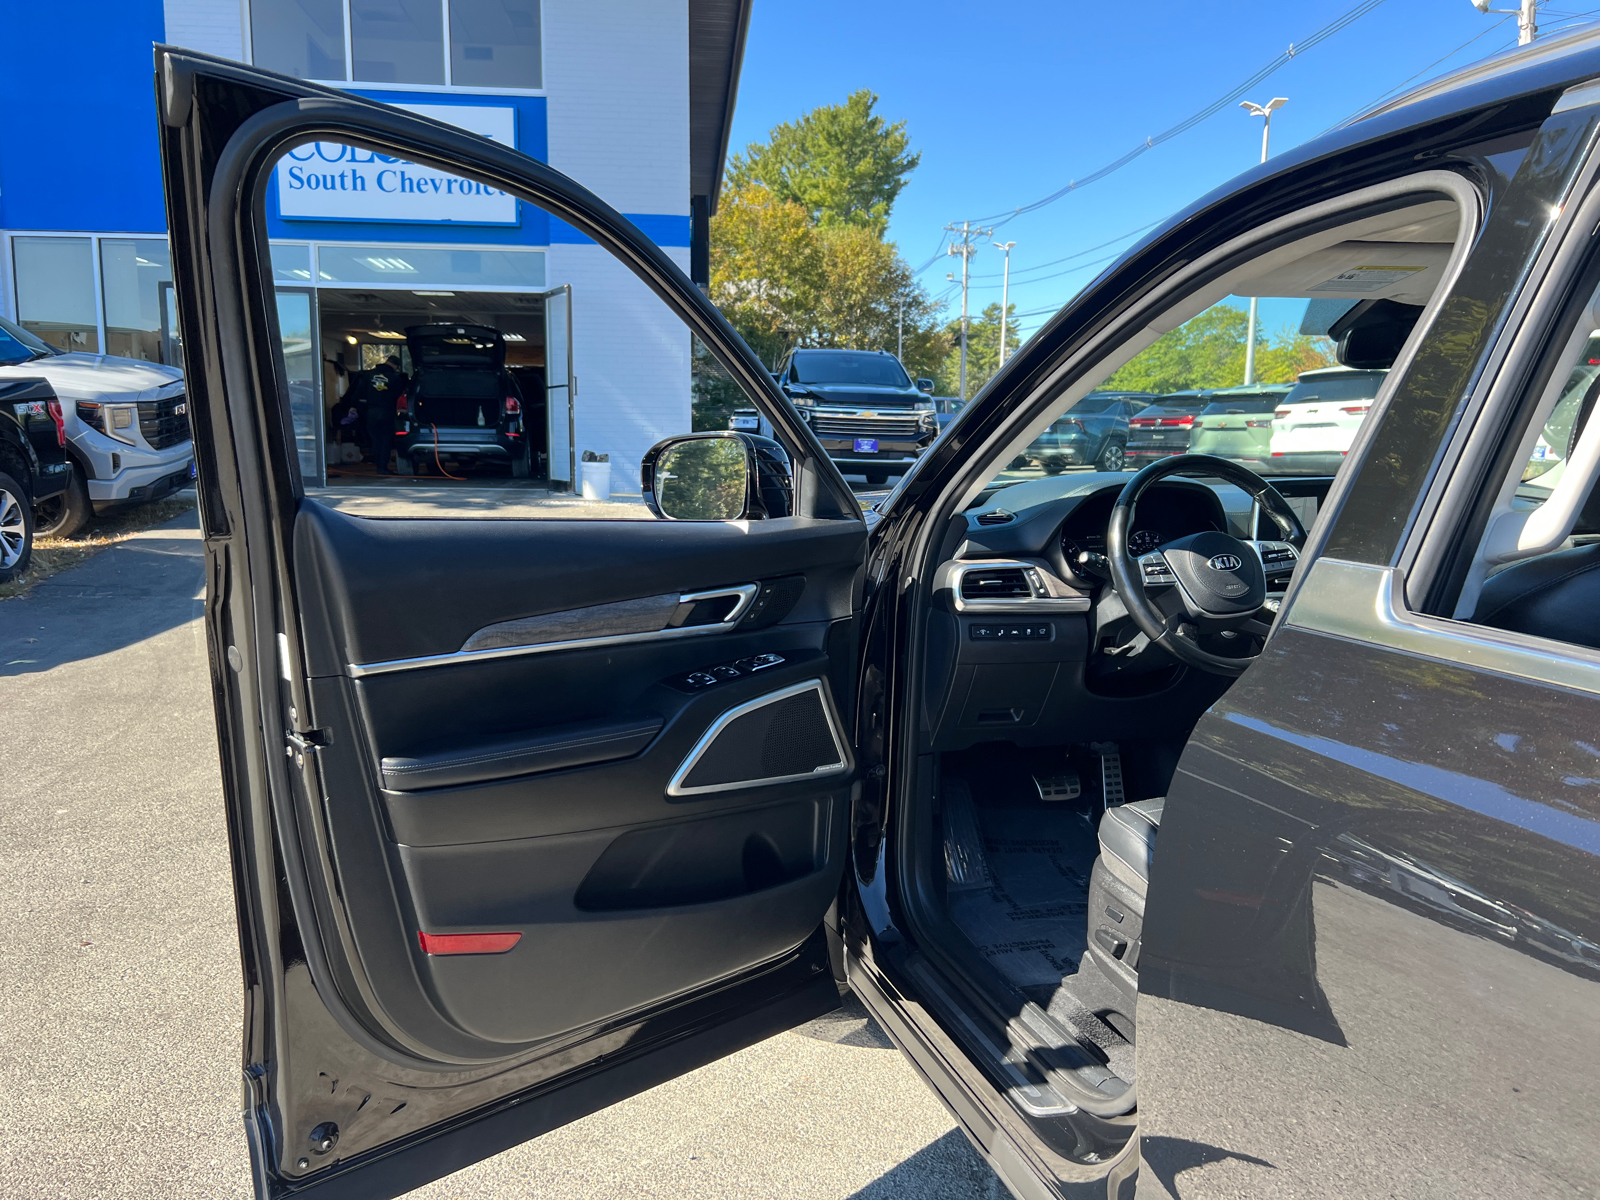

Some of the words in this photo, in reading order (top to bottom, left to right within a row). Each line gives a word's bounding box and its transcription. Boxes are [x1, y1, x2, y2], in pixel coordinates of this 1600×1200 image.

[288, 165, 368, 192] South
[1213, 556, 1239, 570] KIA
[1006, 908, 1041, 917] DEALER
[1018, 943, 1056, 952] DEALER
